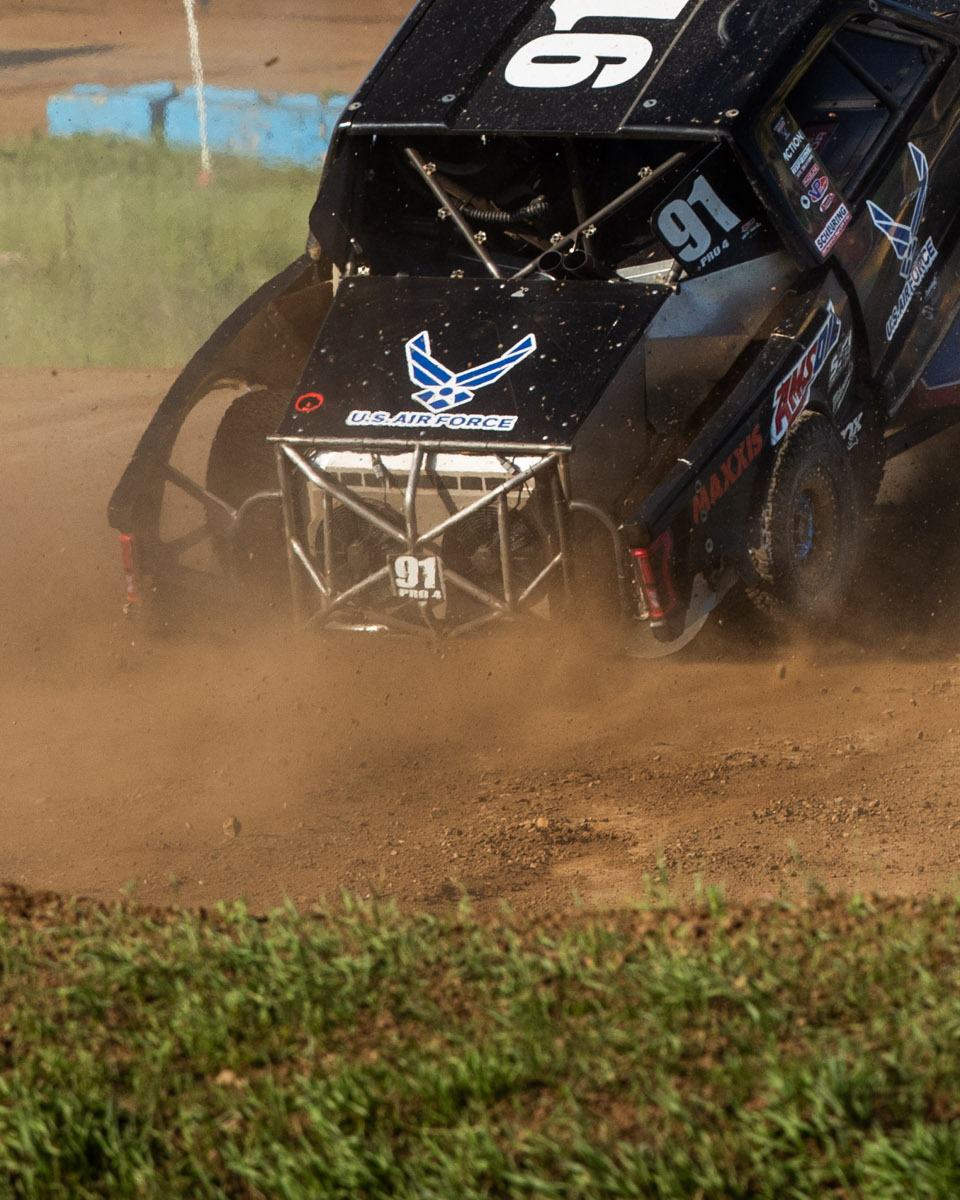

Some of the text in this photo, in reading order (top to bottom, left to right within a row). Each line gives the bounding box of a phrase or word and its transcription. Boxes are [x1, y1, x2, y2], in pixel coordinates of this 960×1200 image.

[657, 173, 741, 263] 91
[700, 245, 721, 268] PRO
[391, 412, 432, 426] AIR
[434, 414, 516, 430] FORCE
[692, 424, 763, 525] MAXXIS
[394, 555, 436, 589] 91
